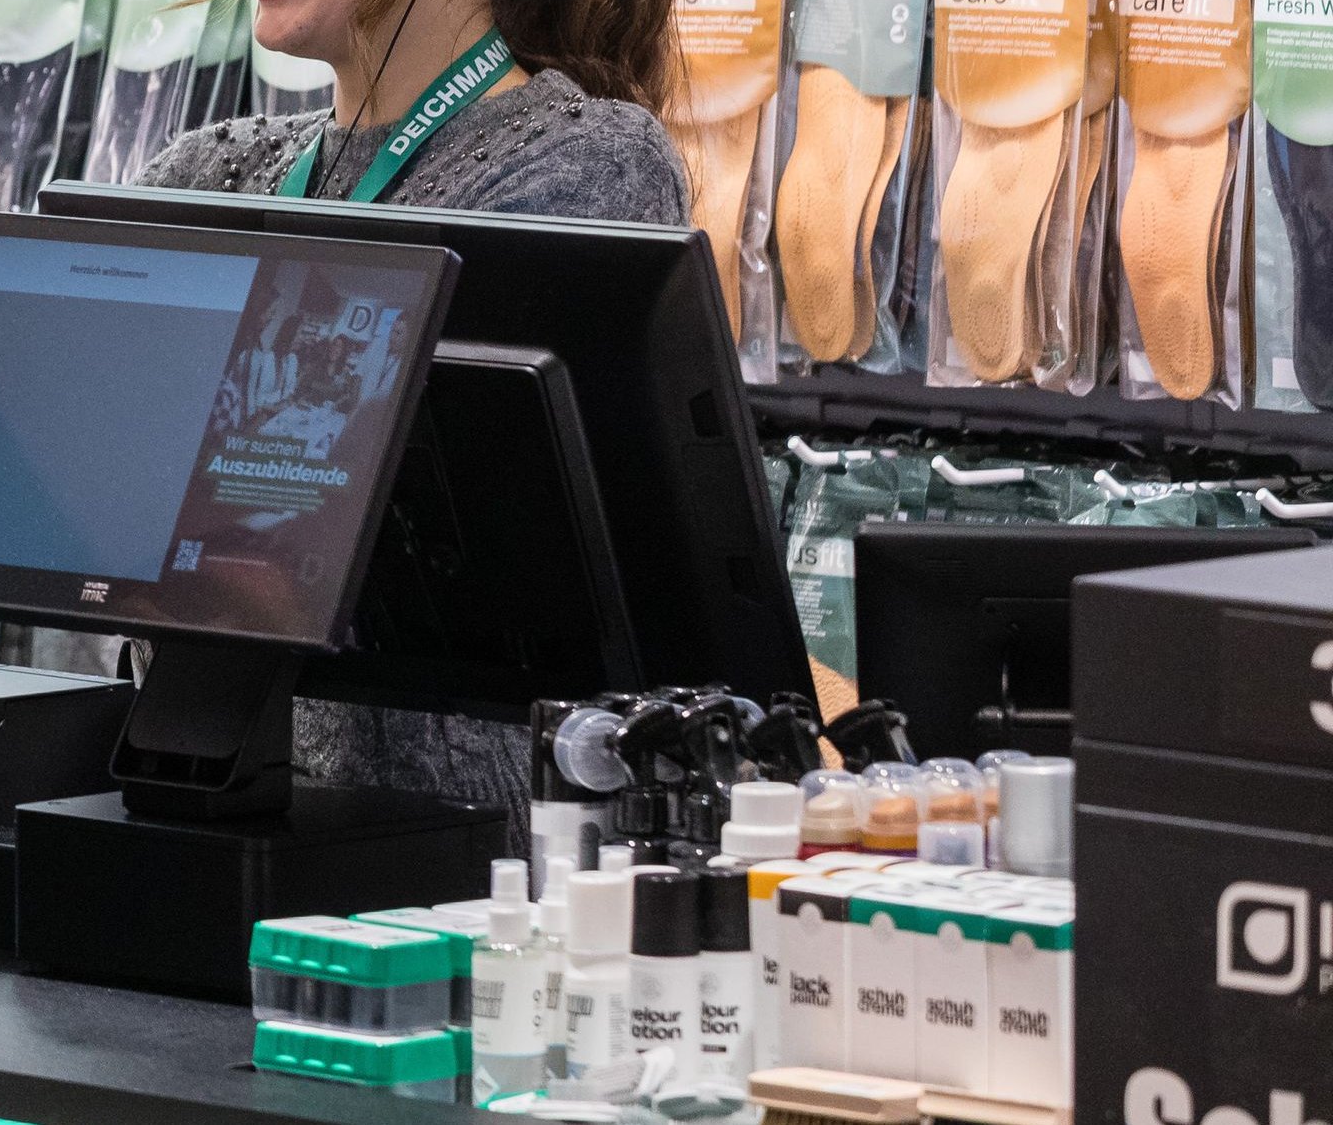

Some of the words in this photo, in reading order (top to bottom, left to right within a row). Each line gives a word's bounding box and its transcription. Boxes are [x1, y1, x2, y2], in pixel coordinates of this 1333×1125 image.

[389, 36, 511, 156] DEICHMANN
[225, 435, 248, 451] Wir
[249, 438, 302, 457] suchen
[207, 454, 349, 487] Auszubildende
[789, 971, 830, 995] lack
